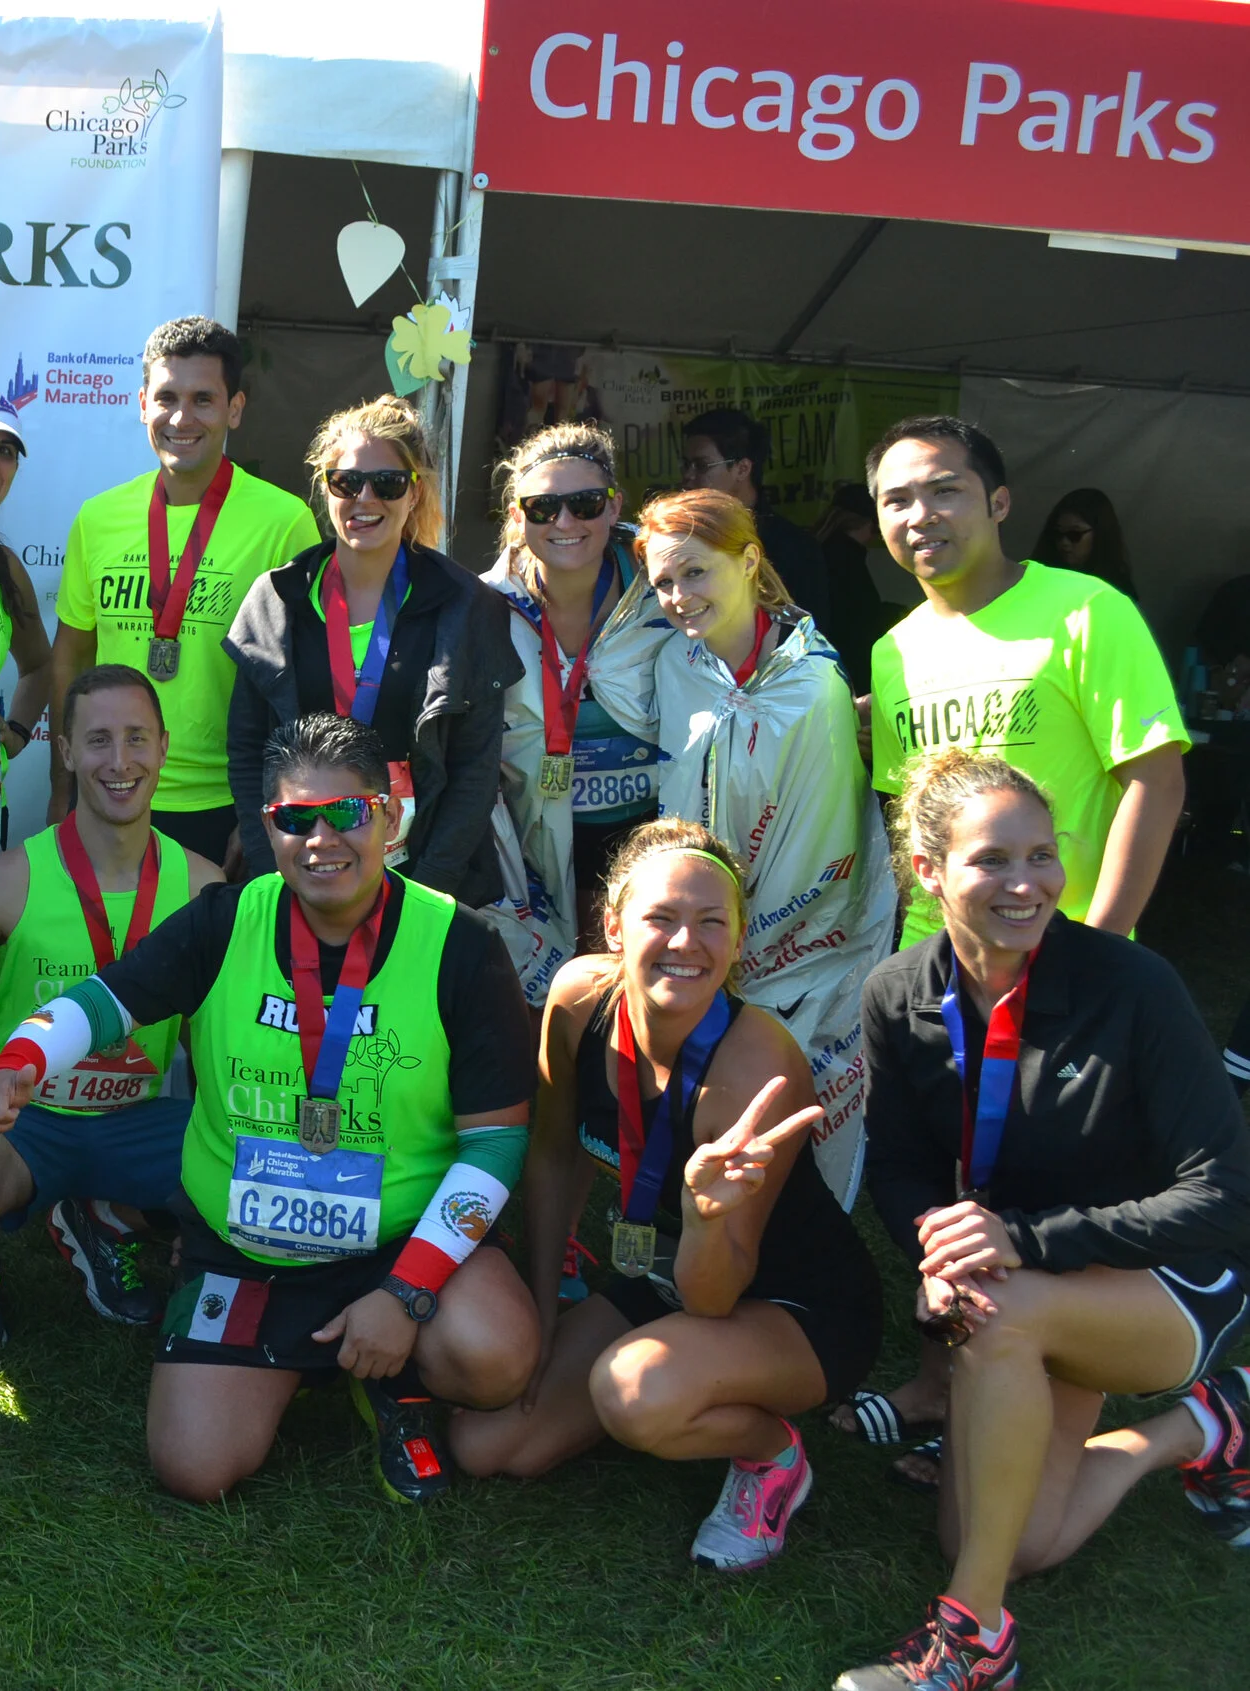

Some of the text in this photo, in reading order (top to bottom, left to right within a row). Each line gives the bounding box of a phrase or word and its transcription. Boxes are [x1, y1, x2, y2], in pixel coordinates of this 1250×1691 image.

[529, 32, 1217, 165] Chicago Parks
[45, 109, 139, 140] Chicago
[91, 134, 148, 156] Parks
[70, 158, 147, 169] FOUNDATION
[47, 352, 134, 366] Bank of America
[45, 369, 114, 389] Chicago
[45, 389, 129, 405] Marathon
[895, 689, 1040, 753] CHICAGO
[572, 773, 651, 806] 28869
[758, 887, 822, 931] America
[33, 957, 89, 977] Team
[226, 1056, 290, 1087] Team
[229, 1118, 273, 1134] CHICAGO
[339, 1133, 385, 1144] NDATION
[265, 1166, 305, 1179] Marathon
[266, 1158, 299, 1171] Chicago
[239, 1189, 367, 1243] G 28864
[295, 1243, 332, 1254] October
